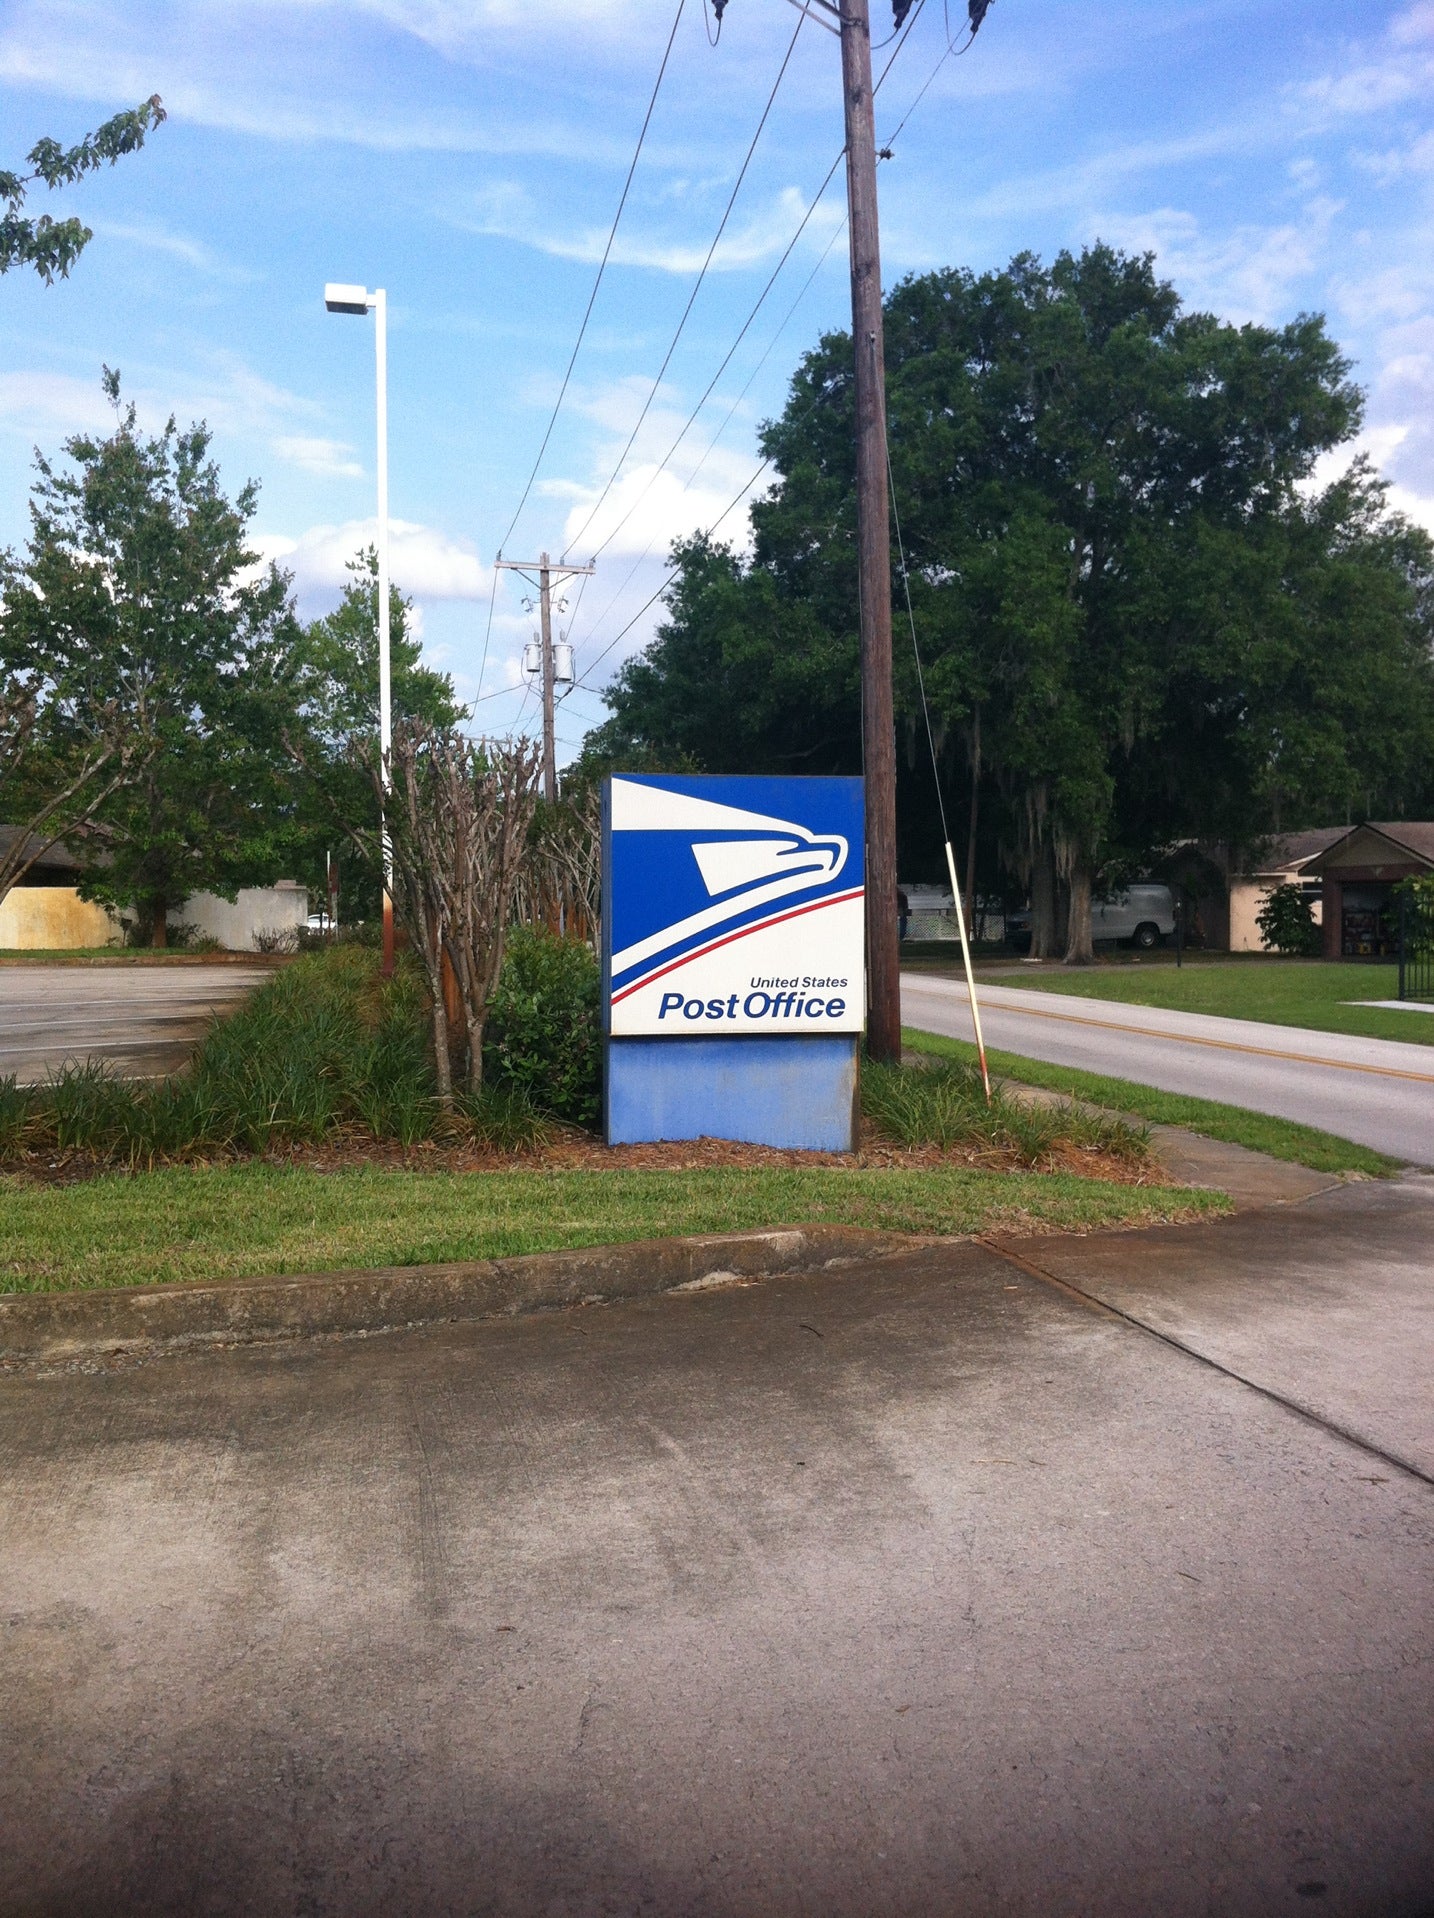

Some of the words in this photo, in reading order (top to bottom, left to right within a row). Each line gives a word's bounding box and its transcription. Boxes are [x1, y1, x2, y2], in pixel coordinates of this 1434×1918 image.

[750, 976, 799, 988] United
[801, 976, 848, 988] States
[658, 992, 740, 1020] Post
[743, 991, 846, 1019] Office
